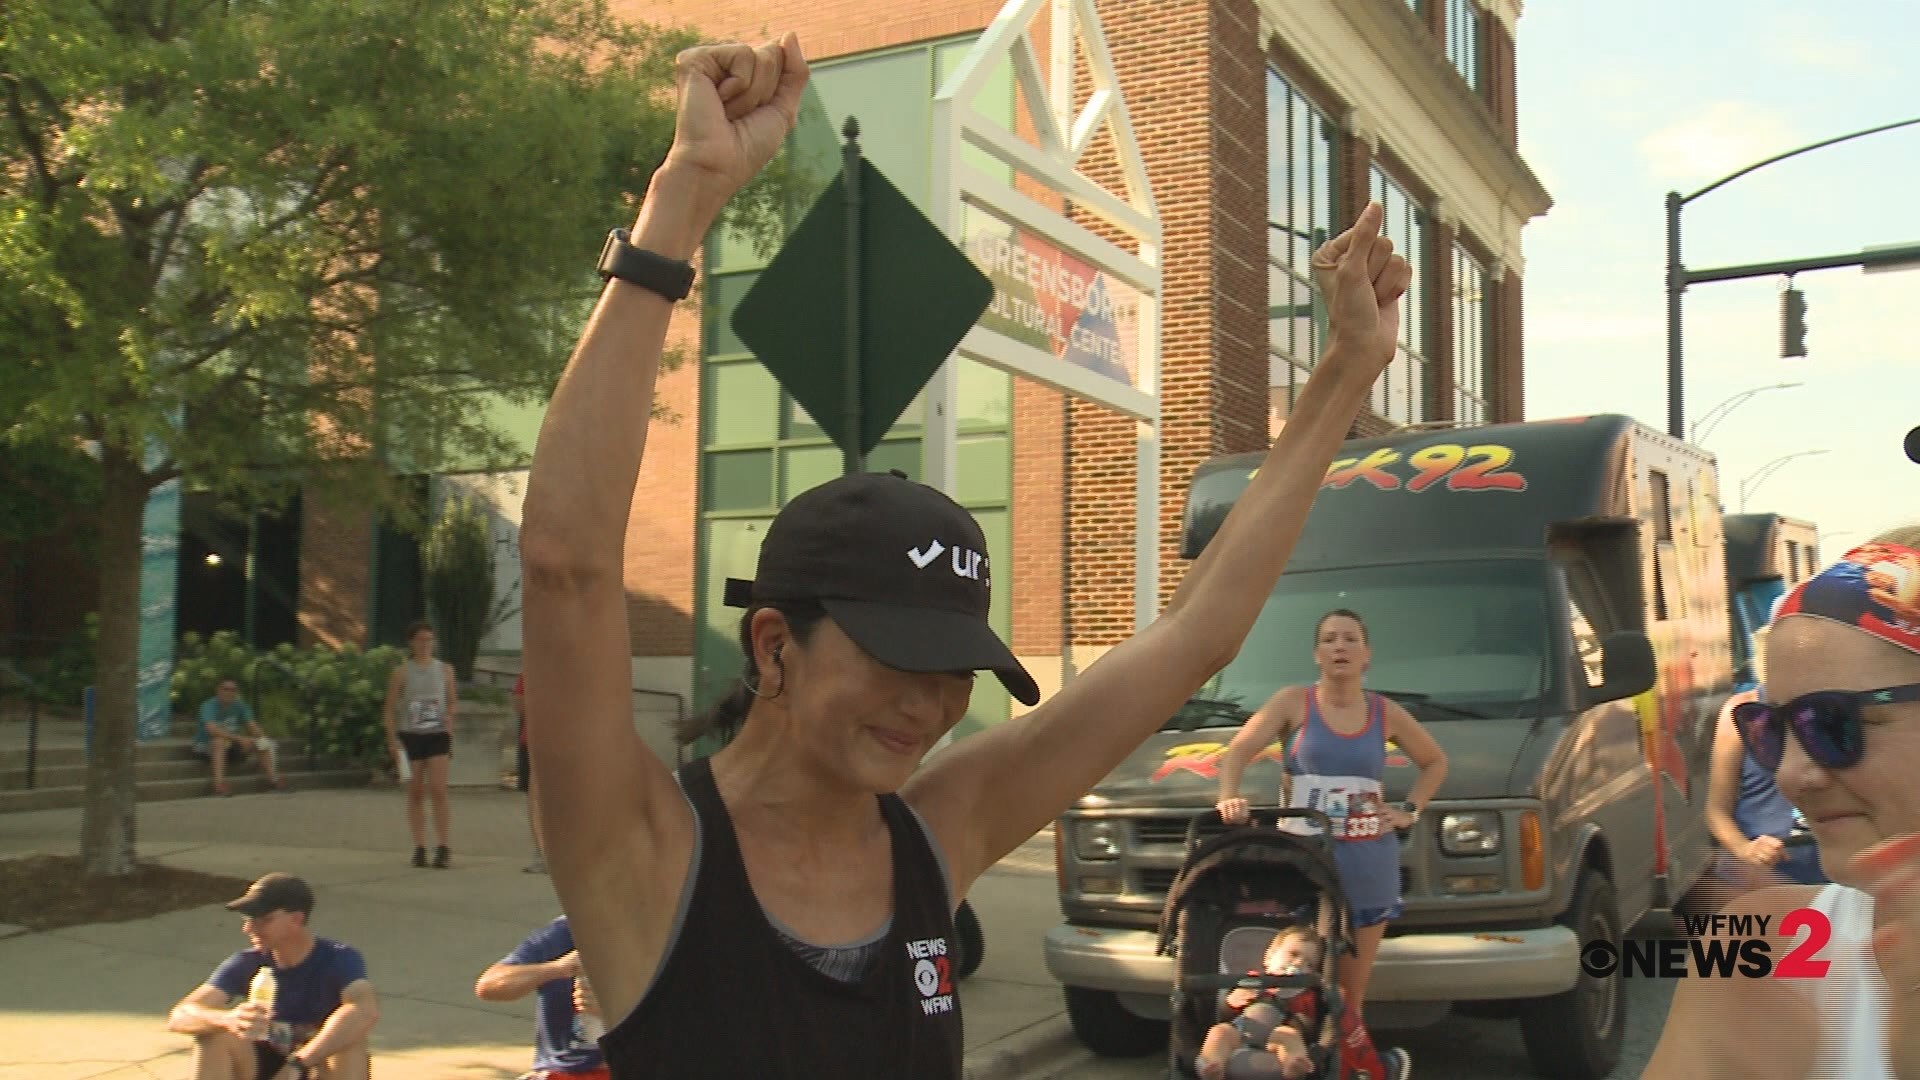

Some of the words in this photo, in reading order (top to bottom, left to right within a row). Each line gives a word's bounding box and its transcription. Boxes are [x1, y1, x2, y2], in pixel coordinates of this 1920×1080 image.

[988, 288, 1067, 343] ULTURAL
[1071, 320, 1122, 365] CENTE
[1406, 444, 1528, 493] 92
[906, 938, 947, 960] NEWS
[936, 956, 952, 995] 2
[920, 995, 953, 1016] WFMY
